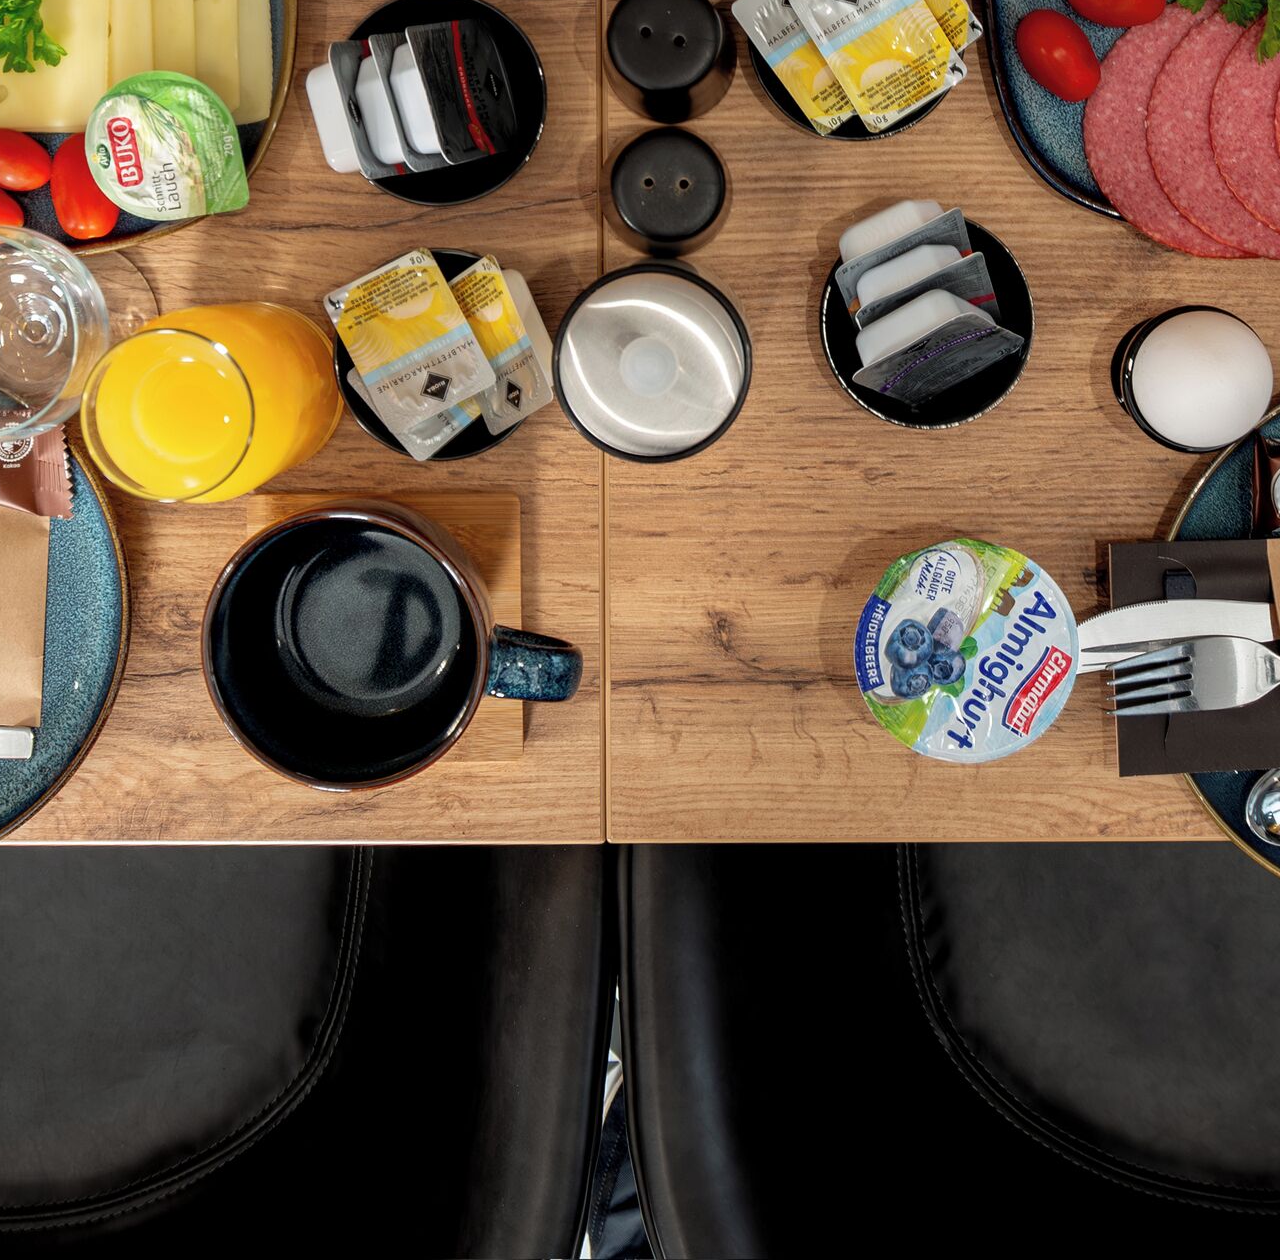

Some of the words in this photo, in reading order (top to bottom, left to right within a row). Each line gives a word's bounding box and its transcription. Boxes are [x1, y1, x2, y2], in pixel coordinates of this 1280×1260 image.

[98, 147, 109, 167] Arla
[111, 120, 139, 183] BUKO
[160, 162, 182, 211] Lauch
[377, 340, 474, 394] HALBFETTMARGARINE
[926, 555, 947, 601] ALLGÄUER
[941, 569, 956, 594] GUTE
[864, 603, 885, 685] HEIDELBEERE
[947, 591, 1057, 749] Almighurt
[1014, 652, 1067, 732] Ehrmann
